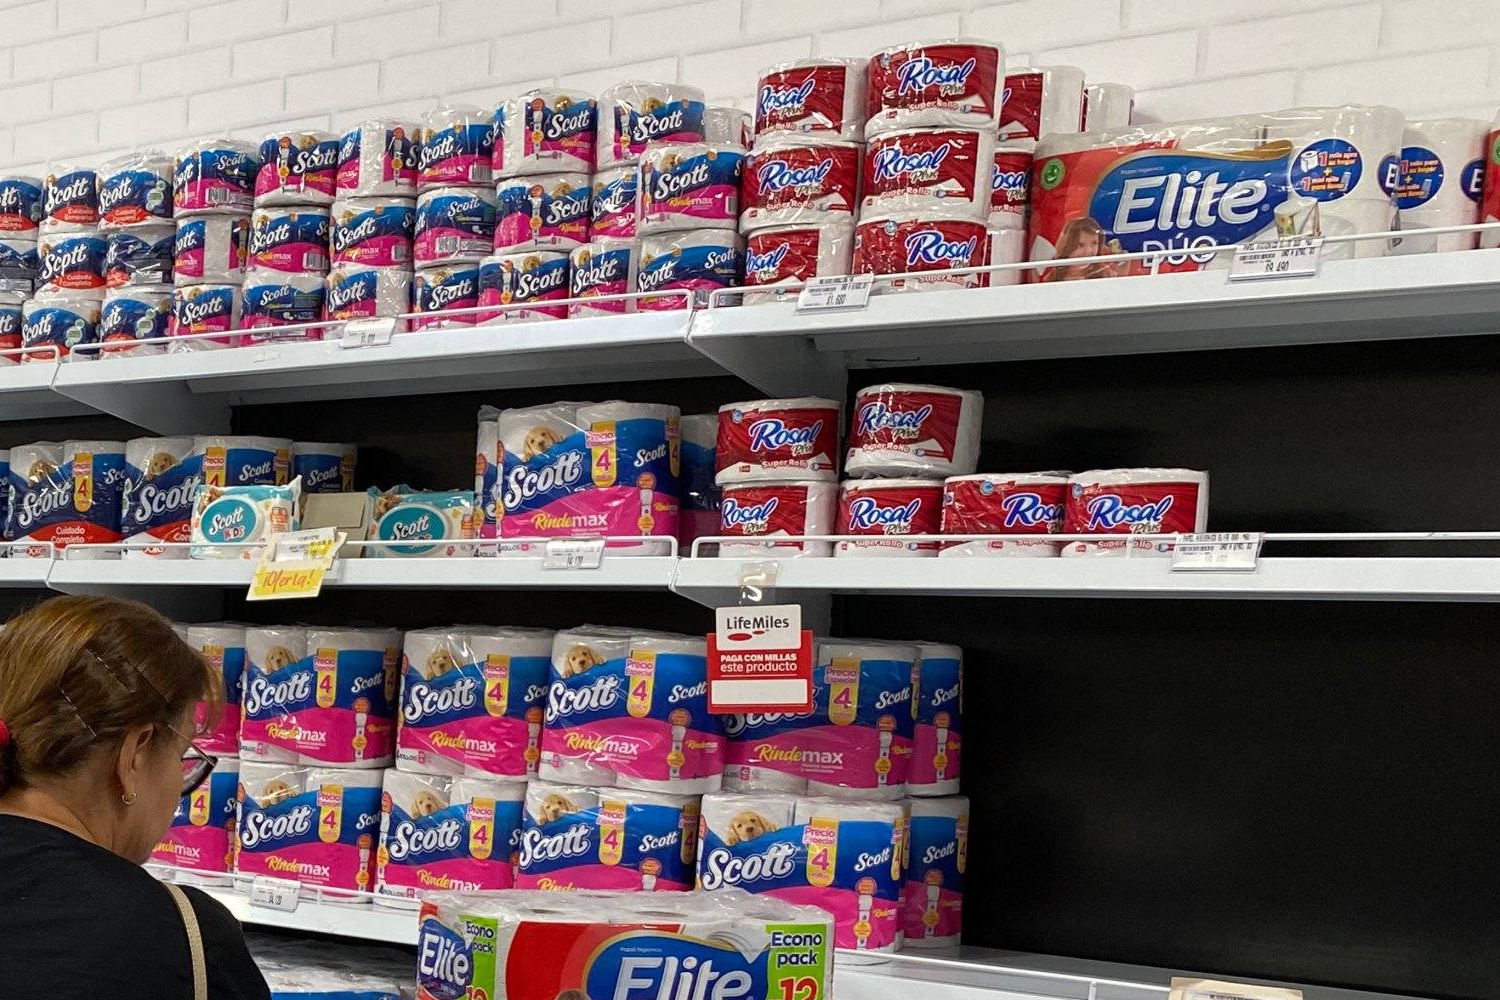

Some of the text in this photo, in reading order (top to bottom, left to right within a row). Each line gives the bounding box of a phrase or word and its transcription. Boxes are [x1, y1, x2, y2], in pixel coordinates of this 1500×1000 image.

[897, 58, 976, 94] Rosal
[548, 112, 590, 138] Scott
[874, 143, 951, 182] Rosal
[47, 171, 90, 204] Scott
[656, 164, 708, 199] Scott
[758, 161, 831, 195] Rosal
[1112, 170, 1268, 234] Elite
[251, 222, 290, 252] Scott
[336, 217, 376, 251] Scott
[906, 230, 978, 264] Rosal
[519, 267, 564, 300] Scott
[182, 295, 223, 325] Scott
[749, 418, 823, 452] Rosal
[858, 403, 933, 437] Rosal
[595, 448, 610, 471] 4
[635, 445, 666, 466] Scott
[239, 461, 271, 481] Scott
[308, 465, 337, 485] Scott
[504, 449, 583, 507] Scott
[19, 483, 71, 525] Scott
[722, 498, 777, 528] Rosal
[849, 498, 922, 529] Rosal
[1088, 495, 1174, 529] Rosal
[55, 526, 85, 536] Cuidado
[209, 507, 244, 534] Scott
[531, 512, 608, 530] Rindemax
[263, 570, 314, 593] ¡Oferta!
[726, 616, 789, 629] LifeMiles
[721, 661, 797, 673] este producto
[765, 653, 797, 661] MILLAS
[247, 674, 313, 716] Scott
[320, 675, 332, 693] 4
[632, 681, 648, 703] 4
[404, 679, 476, 722] Scott
[546, 676, 619, 723] Scott
[266, 724, 326, 742] Rindemax
[429, 731, 496, 753] Rindemax
[564, 732, 639, 755] Rindemax
[754, 744, 843, 766] Rindemax
[194, 796, 206, 813] 4
[242, 806, 312, 844] Scott
[390, 821, 460, 859] Scott
[518, 823, 590, 868] Scott
[603, 830, 619, 851] 4
[265, 857, 330, 877] Rindemax
[703, 842, 795, 891] Scott
[811, 848, 830, 871] 4
[416, 870, 481, 892] Rindemax
[771, 932, 822, 946] Econo
[420, 932, 471, 986] Elite
[777, 951, 817, 968] pack
